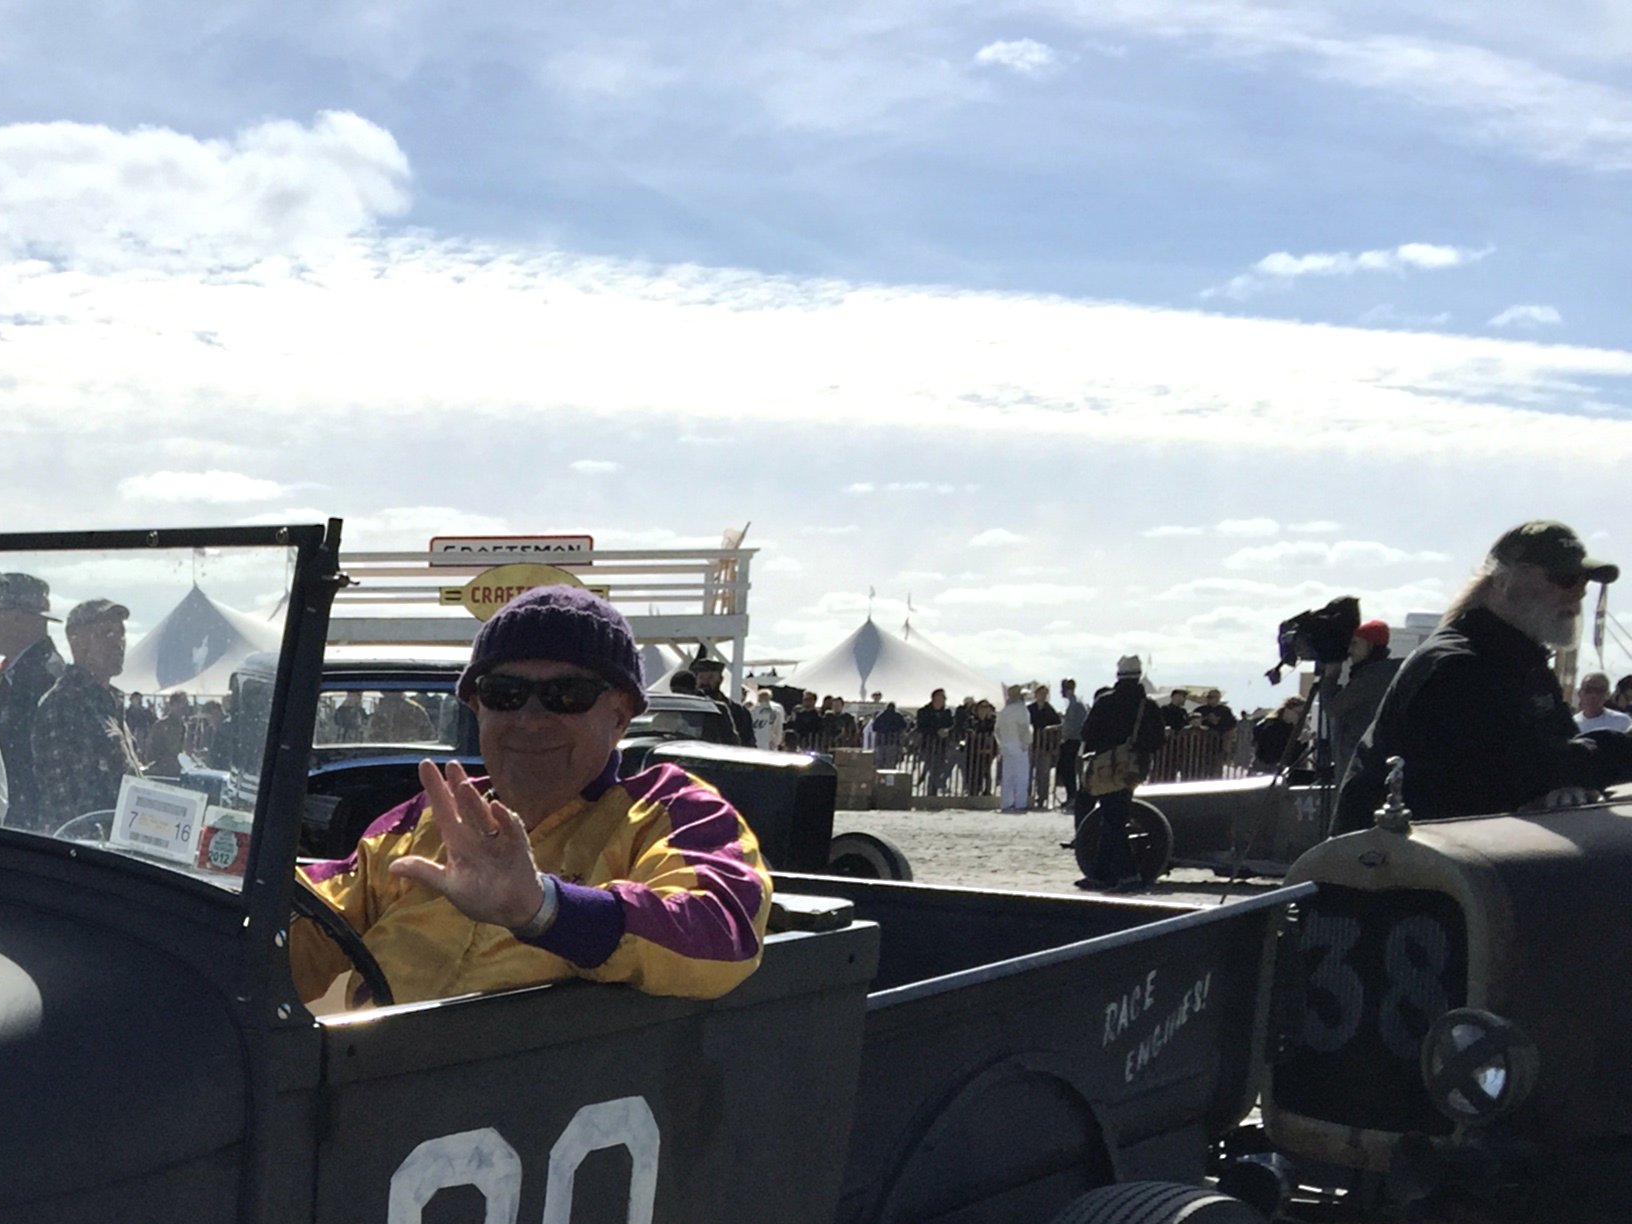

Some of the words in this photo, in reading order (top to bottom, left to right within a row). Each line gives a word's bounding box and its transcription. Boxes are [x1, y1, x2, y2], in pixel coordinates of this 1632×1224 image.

[128, 810, 139, 828] 7
[174, 821, 192, 842] 16
[1102, 969, 1158, 1048] RACE
[1300, 911, 1449, 1059] 38
